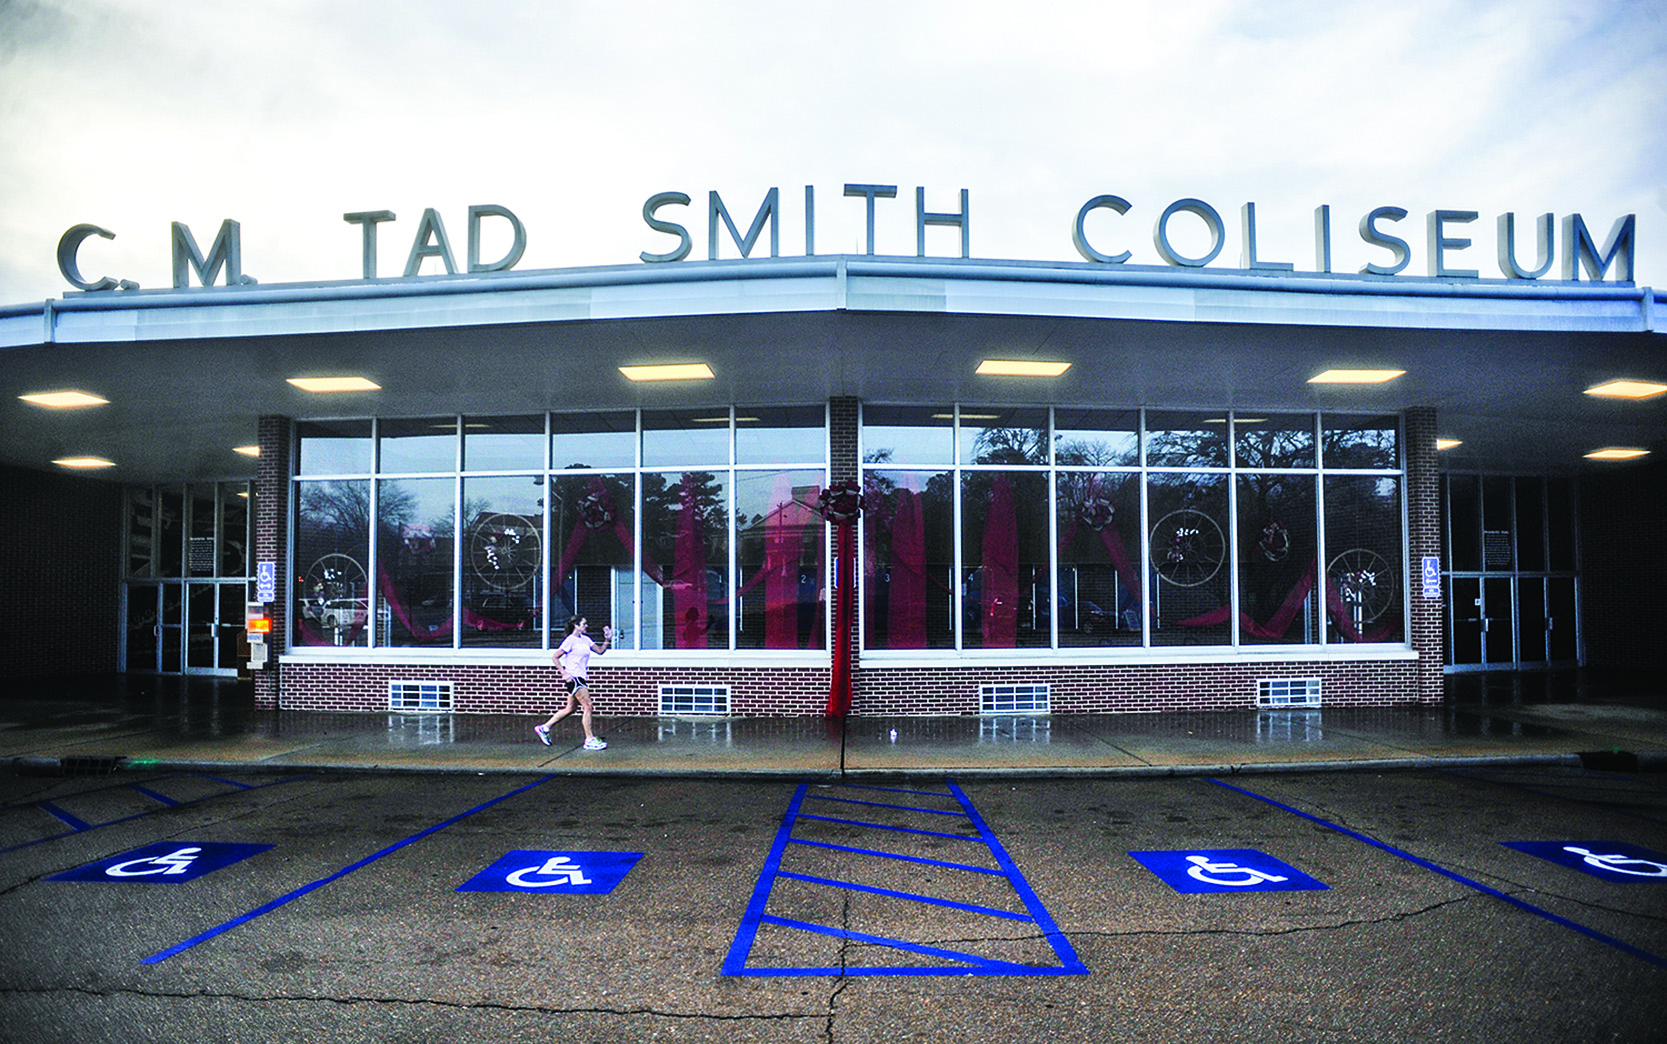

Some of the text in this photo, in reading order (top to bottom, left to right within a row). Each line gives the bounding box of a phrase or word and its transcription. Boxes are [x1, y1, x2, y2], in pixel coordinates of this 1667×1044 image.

[57, 184, 1636, 291] C. M. TAD SMITH COLISEUM
[801, 574, 807, 583] 2
[885, 573, 891, 583] 3
